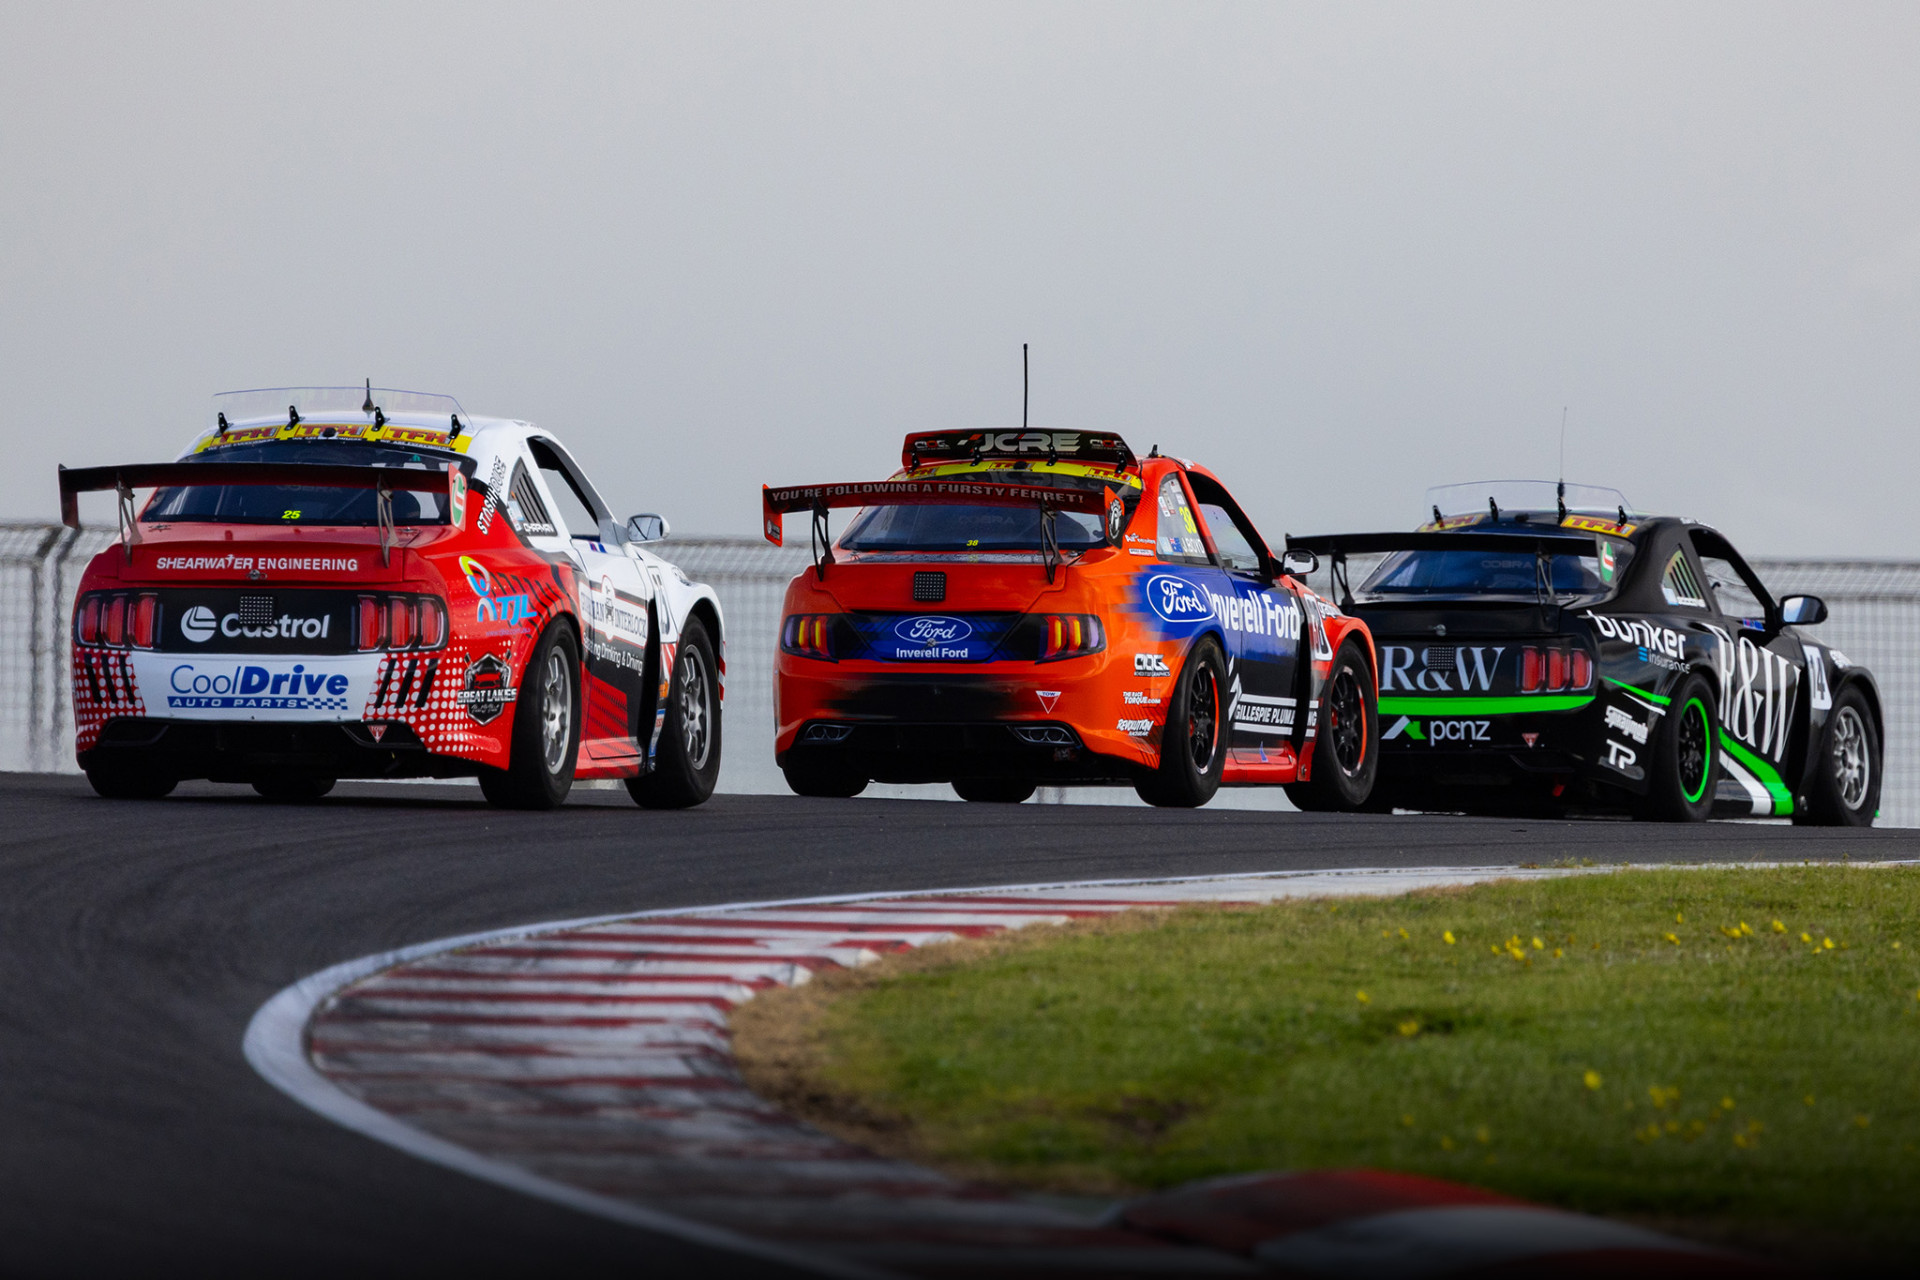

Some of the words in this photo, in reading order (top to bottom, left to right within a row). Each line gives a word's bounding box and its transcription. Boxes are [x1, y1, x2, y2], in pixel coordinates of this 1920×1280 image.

[979, 433, 1081, 453] JCRE
[771, 487, 823, 502] YOU'RE
[826, 483, 918, 497] FOLLOWING
[922, 483, 933, 492] A
[938, 483, 1004, 496] FURSTY
[1010, 488, 1084, 504] FERRET!
[282, 510, 301, 520] 25
[1178, 506, 1198, 534] 38
[966, 539, 979, 547] 38
[156, 554, 253, 570] SHEARWATER
[258, 558, 358, 572] ENGINEERING
[1481, 559, 1533, 569] COBRA
[1160, 579, 1207, 615] Ford
[1201, 584, 1264, 634] Inverell
[1261, 593, 1301, 641] Ford
[909, 618, 957, 639] Ford
[1587, 609, 1687, 660] bunker
[896, 647, 939, 658] Inverell
[941, 648, 968, 658] Ford
[1649, 650, 1691, 674] insurance
[1380, 646, 1506, 691] R&W
[170, 664, 349, 695] CoolDrive
[172, 698, 221, 708] AUTO
[233, 698, 298, 708] PARTS
[457, 690, 486, 703] GREAT
[487, 688, 517, 702] LAKES
[1701, 622, 1801, 764] R&W
[1235, 704, 1273, 723] GILLESPIE
[1429, 720, 1491, 746] pcnz
